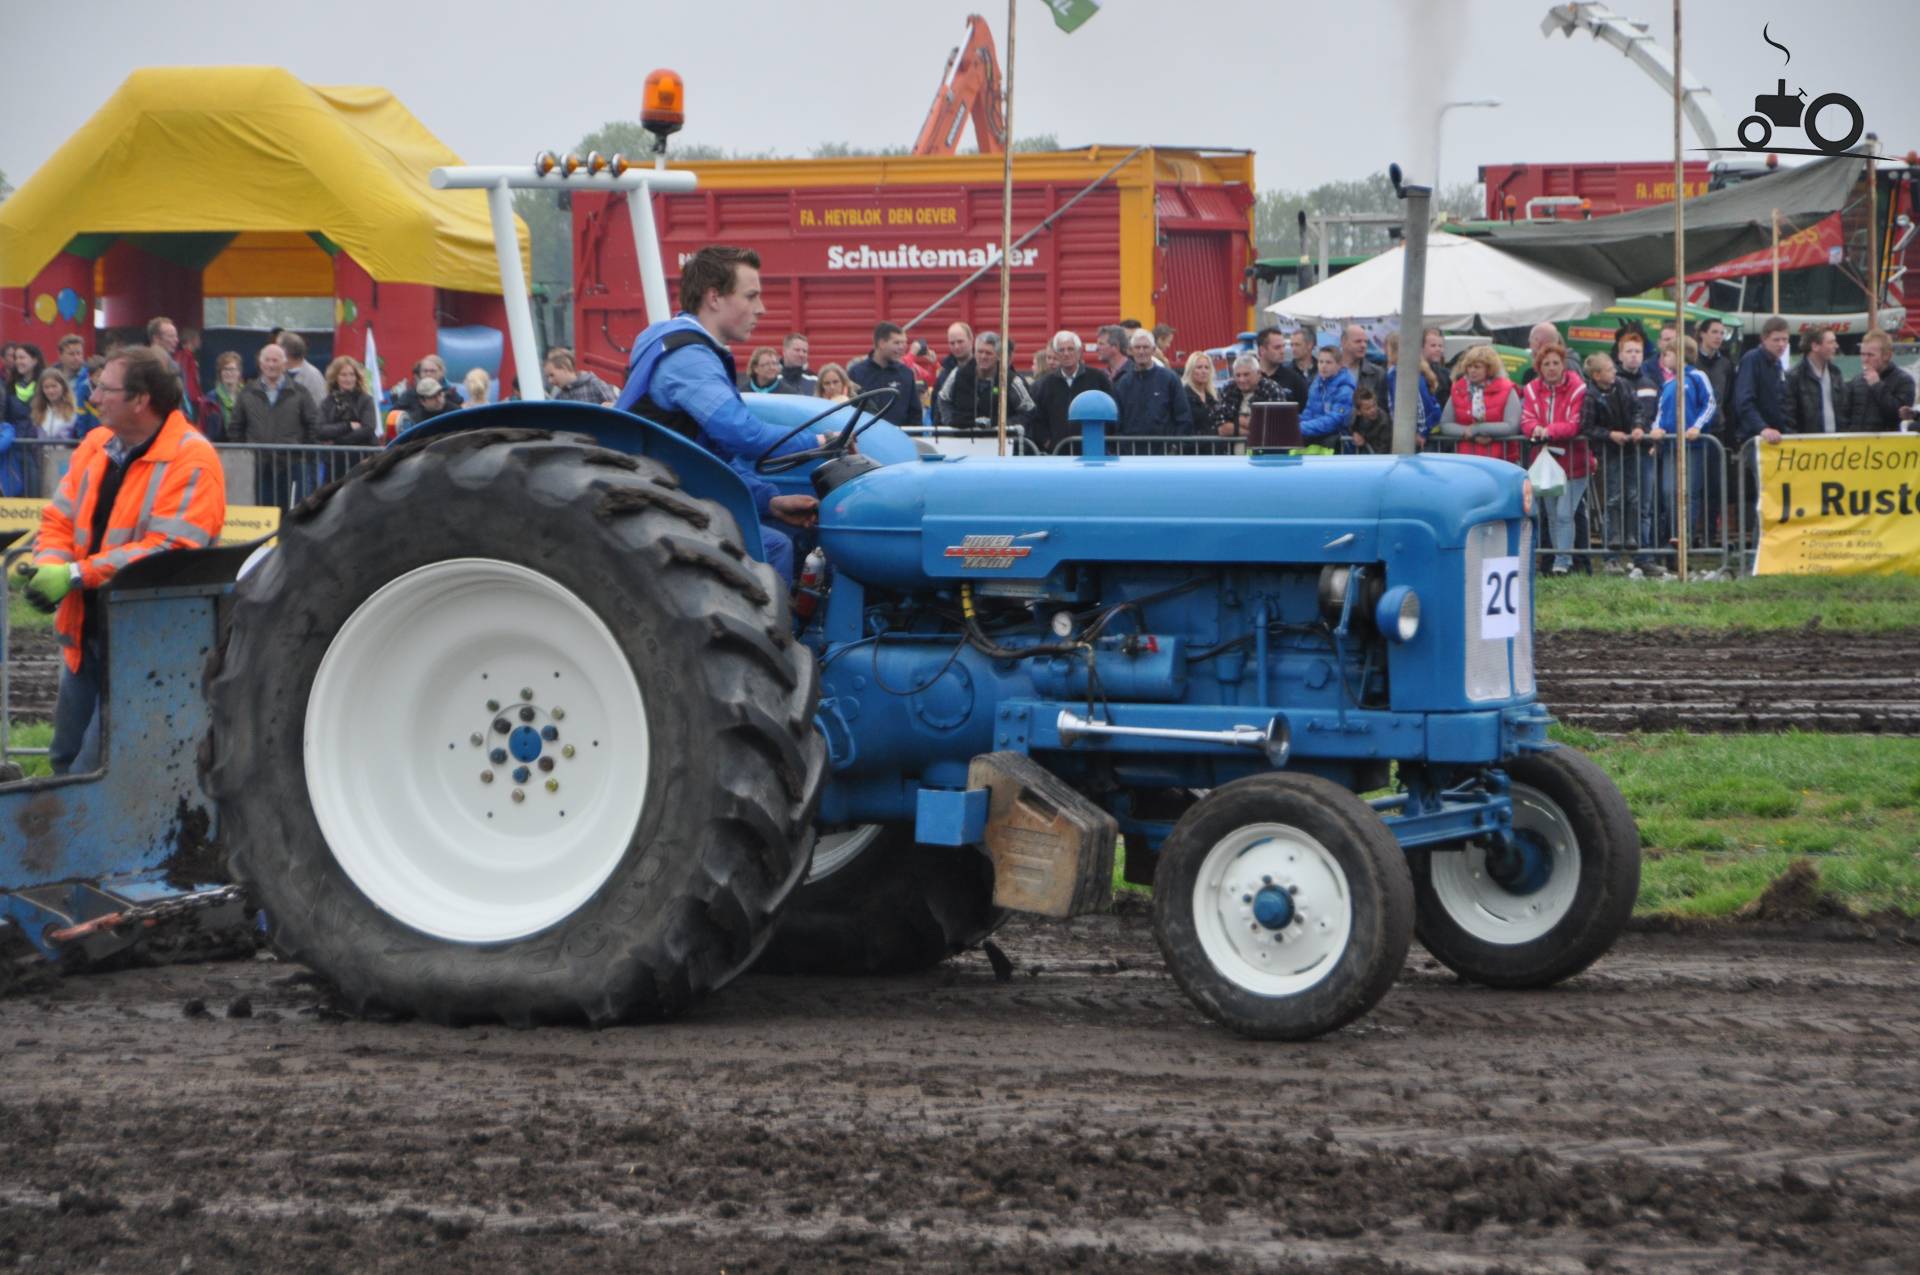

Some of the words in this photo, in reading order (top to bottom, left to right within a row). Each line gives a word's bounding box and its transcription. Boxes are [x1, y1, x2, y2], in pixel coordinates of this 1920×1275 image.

[800, 209, 823, 226] FA.
[825, 208, 881, 225] HEYBLOK
[888, 208, 913, 225] DEN
[915, 207, 957, 224] OEVER
[828, 243, 1039, 270] Schuitemaker
[1777, 446, 1918, 472] Handelson
[1779, 483, 1805, 524] J.
